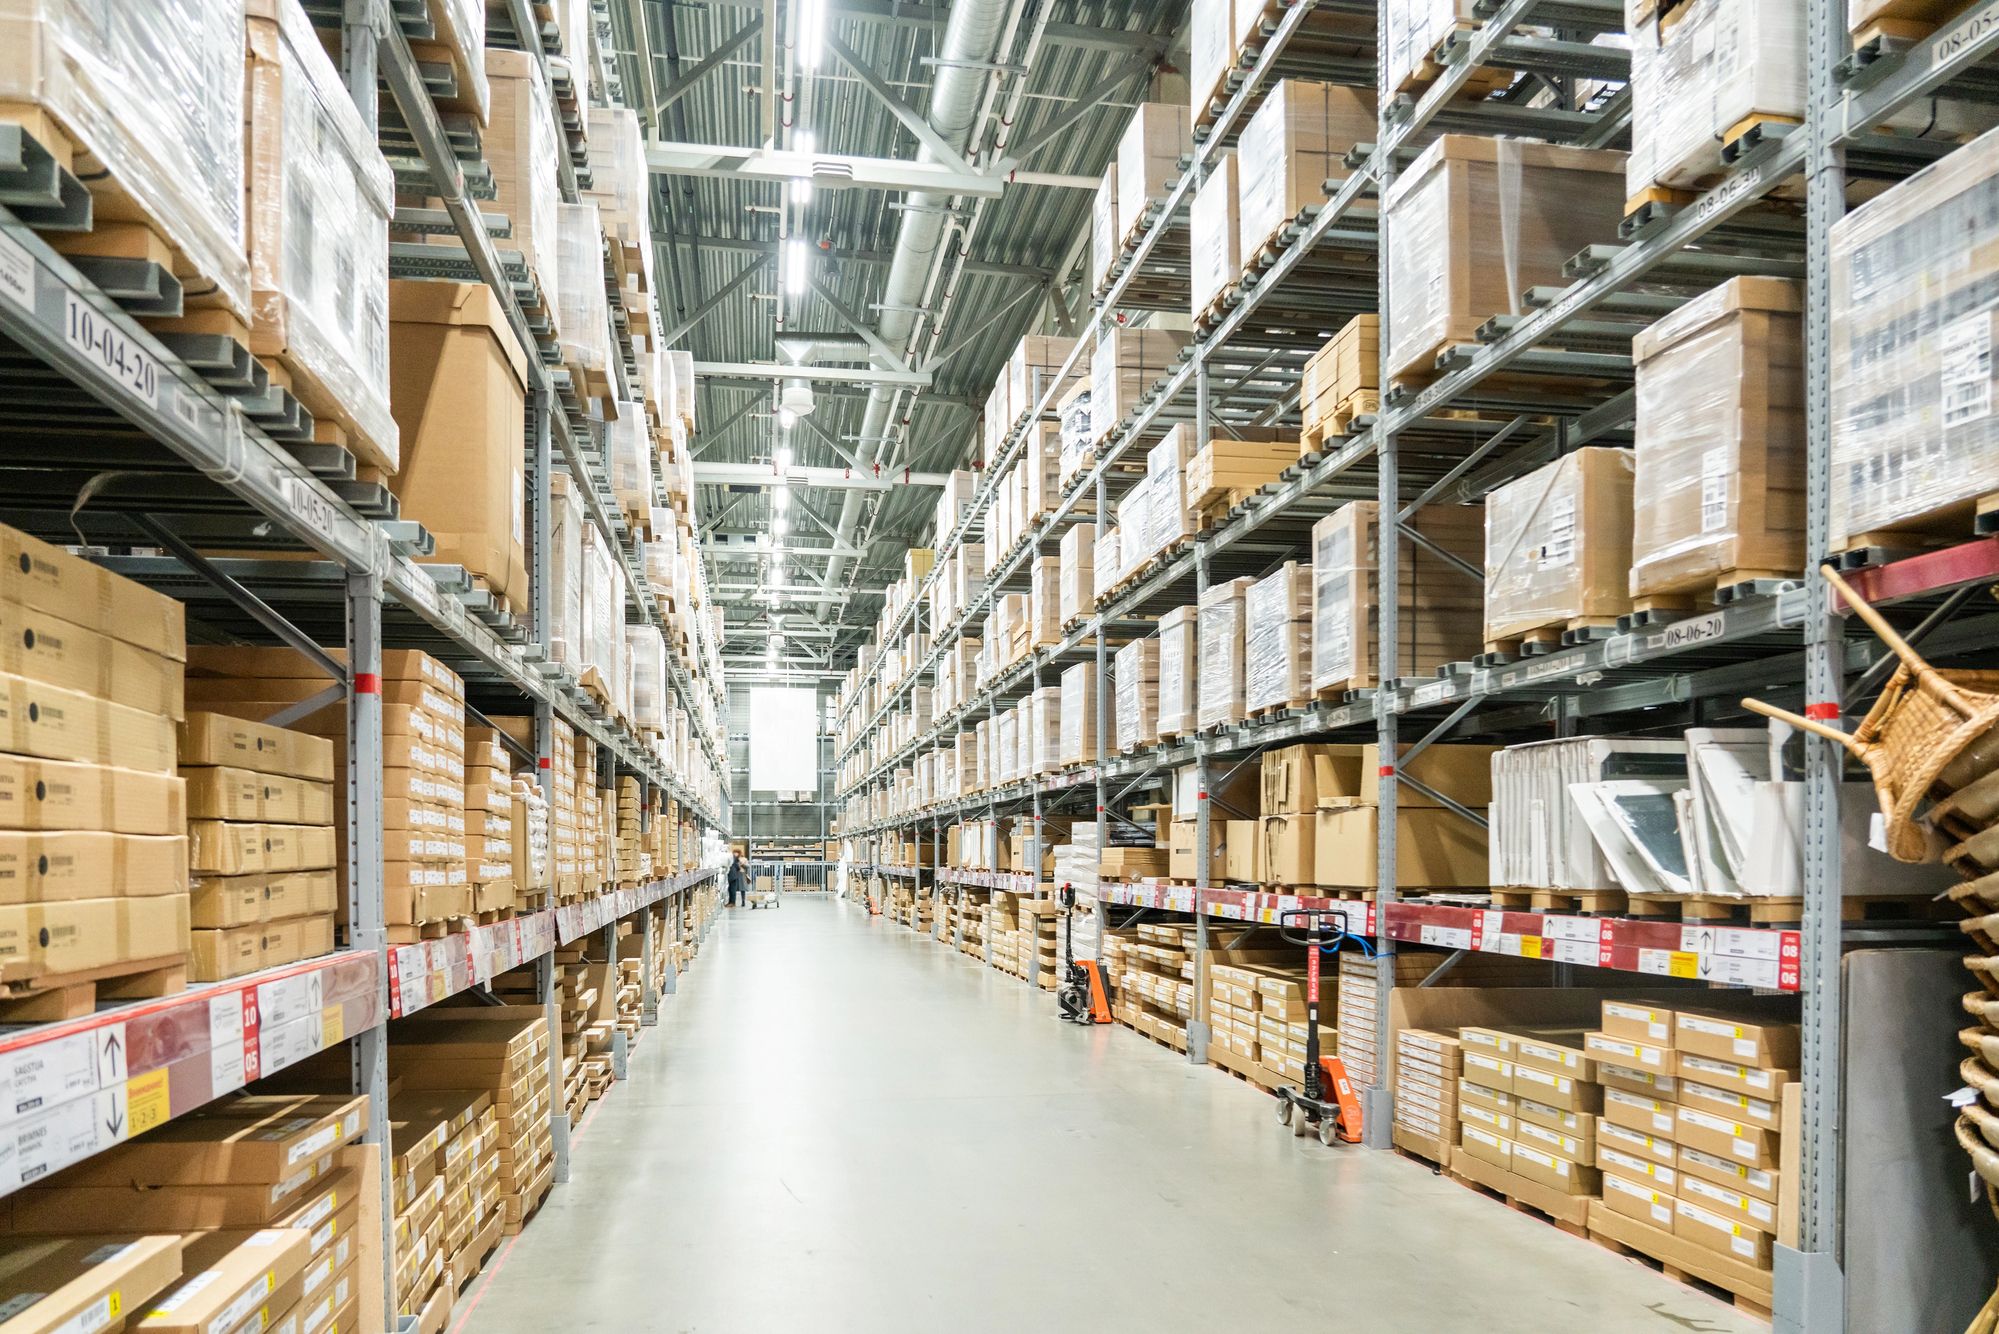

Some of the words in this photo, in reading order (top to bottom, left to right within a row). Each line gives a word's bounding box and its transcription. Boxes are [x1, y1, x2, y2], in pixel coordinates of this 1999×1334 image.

[70, 302, 155, 398] 10-04-20
[291, 483, 333, 535] 10-05-20
[1667, 618, 1722, 646] 08-06-20
[1601, 930, 1613, 940] 08
[1600, 952, 1611, 963] 07
[1781, 945, 1798, 958] 08
[1780, 972, 1798, 985] 06
[244, 1005, 257, 1028] 10
[245, 1050, 258, 1073] 05
